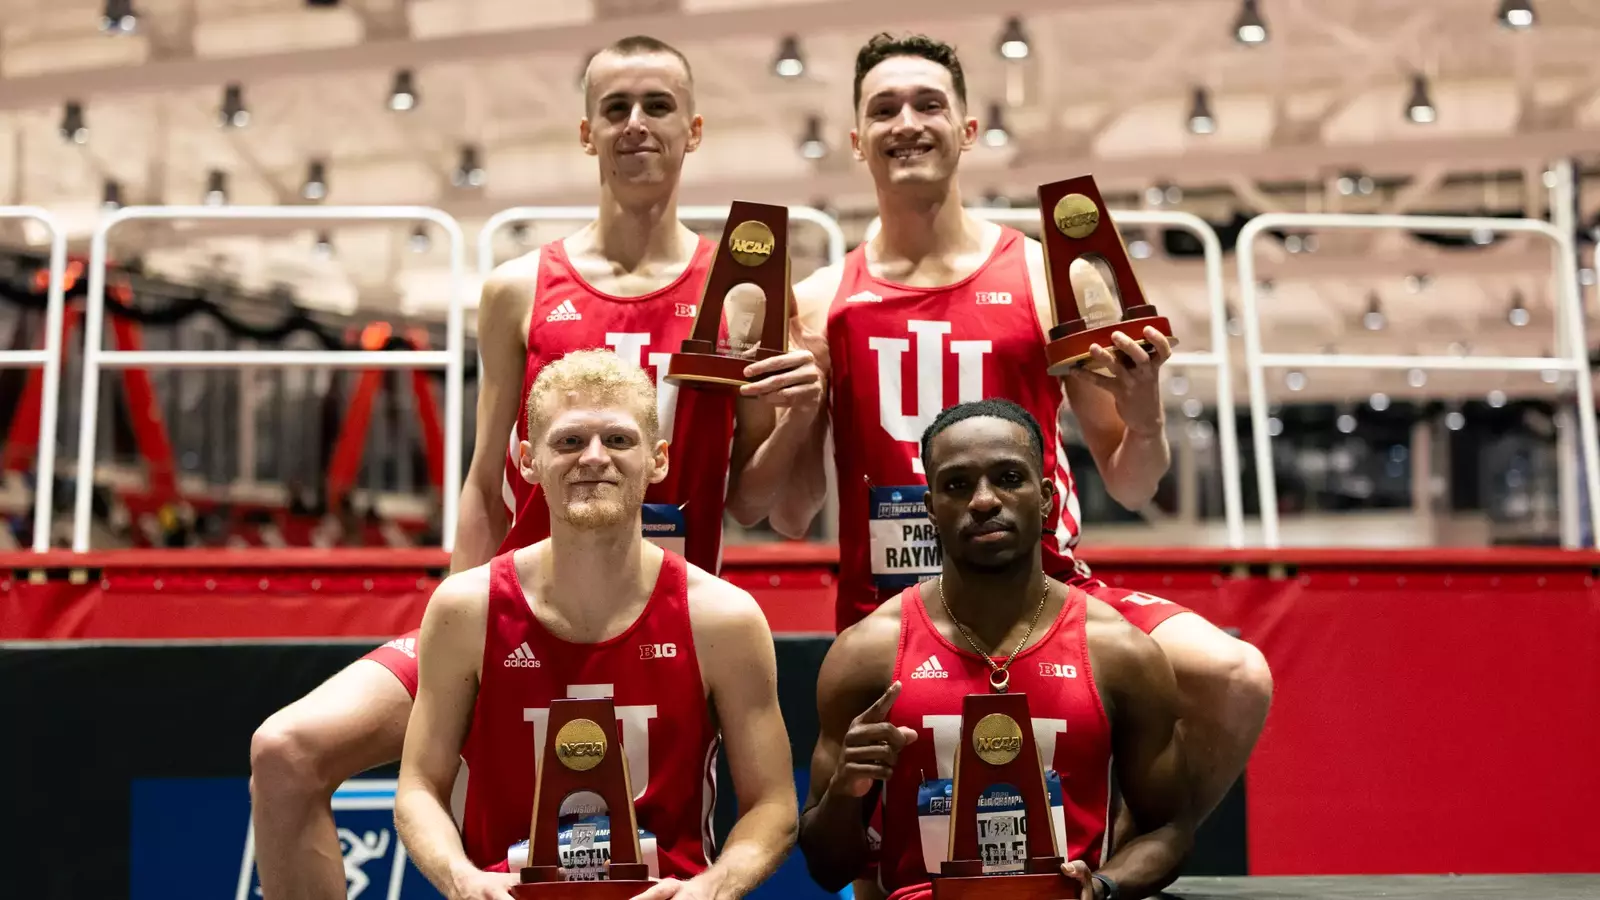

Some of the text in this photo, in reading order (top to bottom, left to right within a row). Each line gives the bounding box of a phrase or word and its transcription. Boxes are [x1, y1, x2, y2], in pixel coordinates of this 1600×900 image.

[731, 237, 773, 256] NCAA
[546, 311, 582, 323] adidas
[503, 657, 541, 669] adidas
[910, 668, 949, 680] adidas
[560, 740, 605, 758] NCAA
[976, 735, 1021, 753] NCAA
